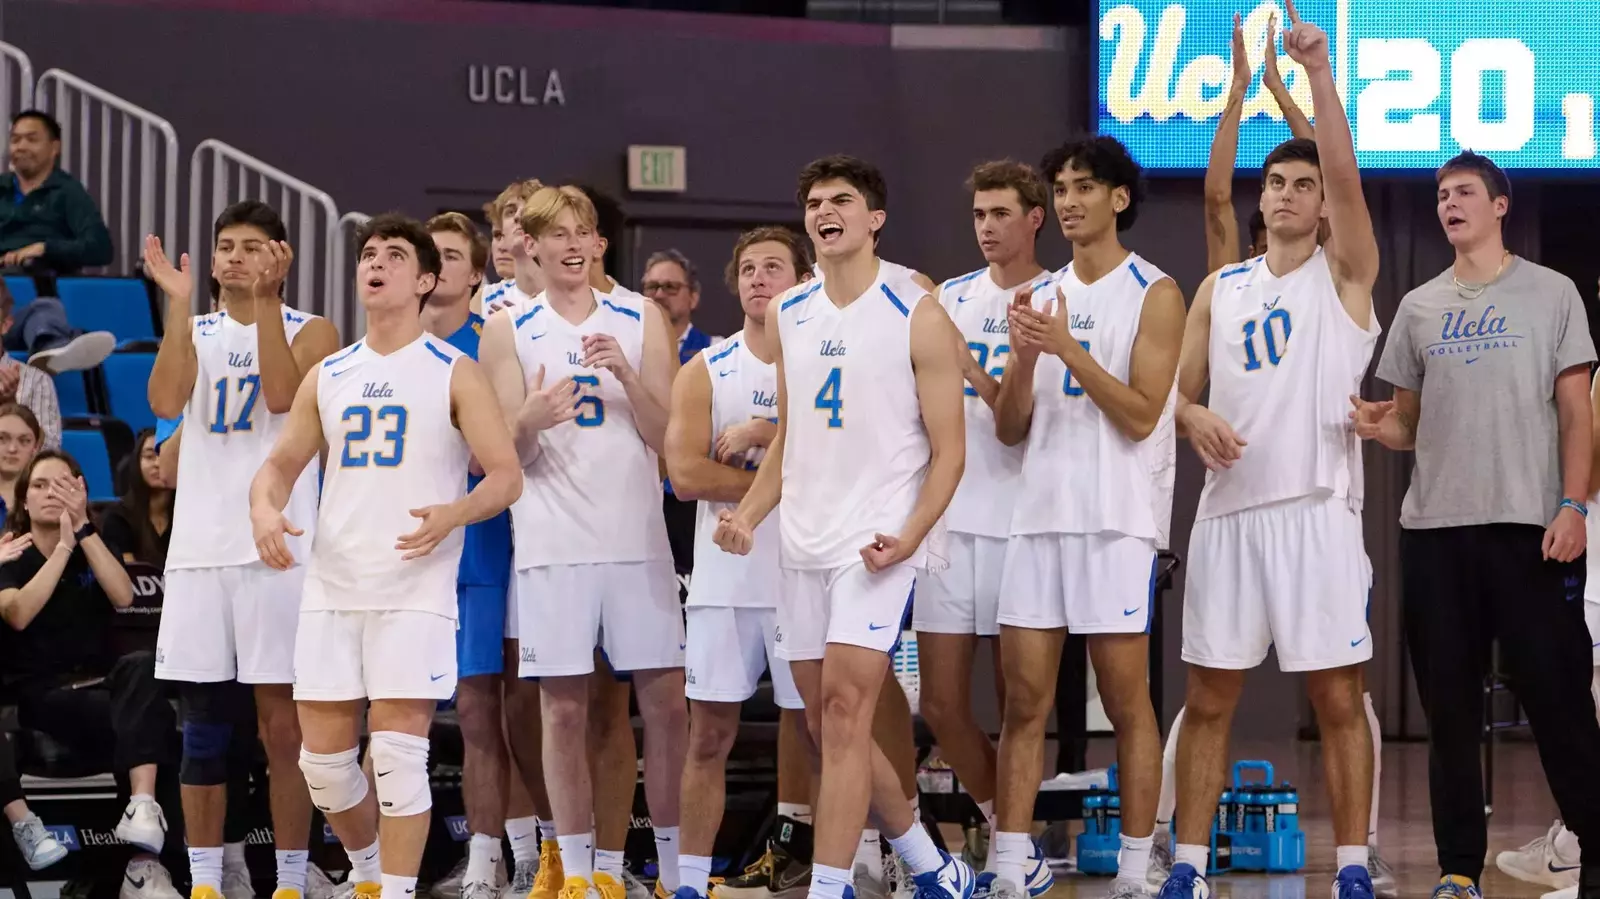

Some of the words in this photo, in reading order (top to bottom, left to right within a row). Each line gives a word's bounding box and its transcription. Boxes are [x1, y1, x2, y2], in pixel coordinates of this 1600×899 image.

[468, 64, 566, 106] UCLA
[1357, 37, 1535, 152] 20
[640, 151, 674, 186] EXIT
[1071, 313, 1095, 330] Ucla
[1442, 305, 1508, 340] Ucla
[820, 339, 847, 357] Ucla
[1241, 307, 1293, 373] 10
[1430, 340, 1518, 356] VOLLEYBALL
[228, 351, 253, 368] Ucl
[566, 351, 582, 365] Uc
[209, 373, 262, 435] 17
[362, 382, 394, 399] Ucla
[814, 366, 844, 430] 4
[340, 404, 408, 469] 23
[452, 820, 469, 835] UC
